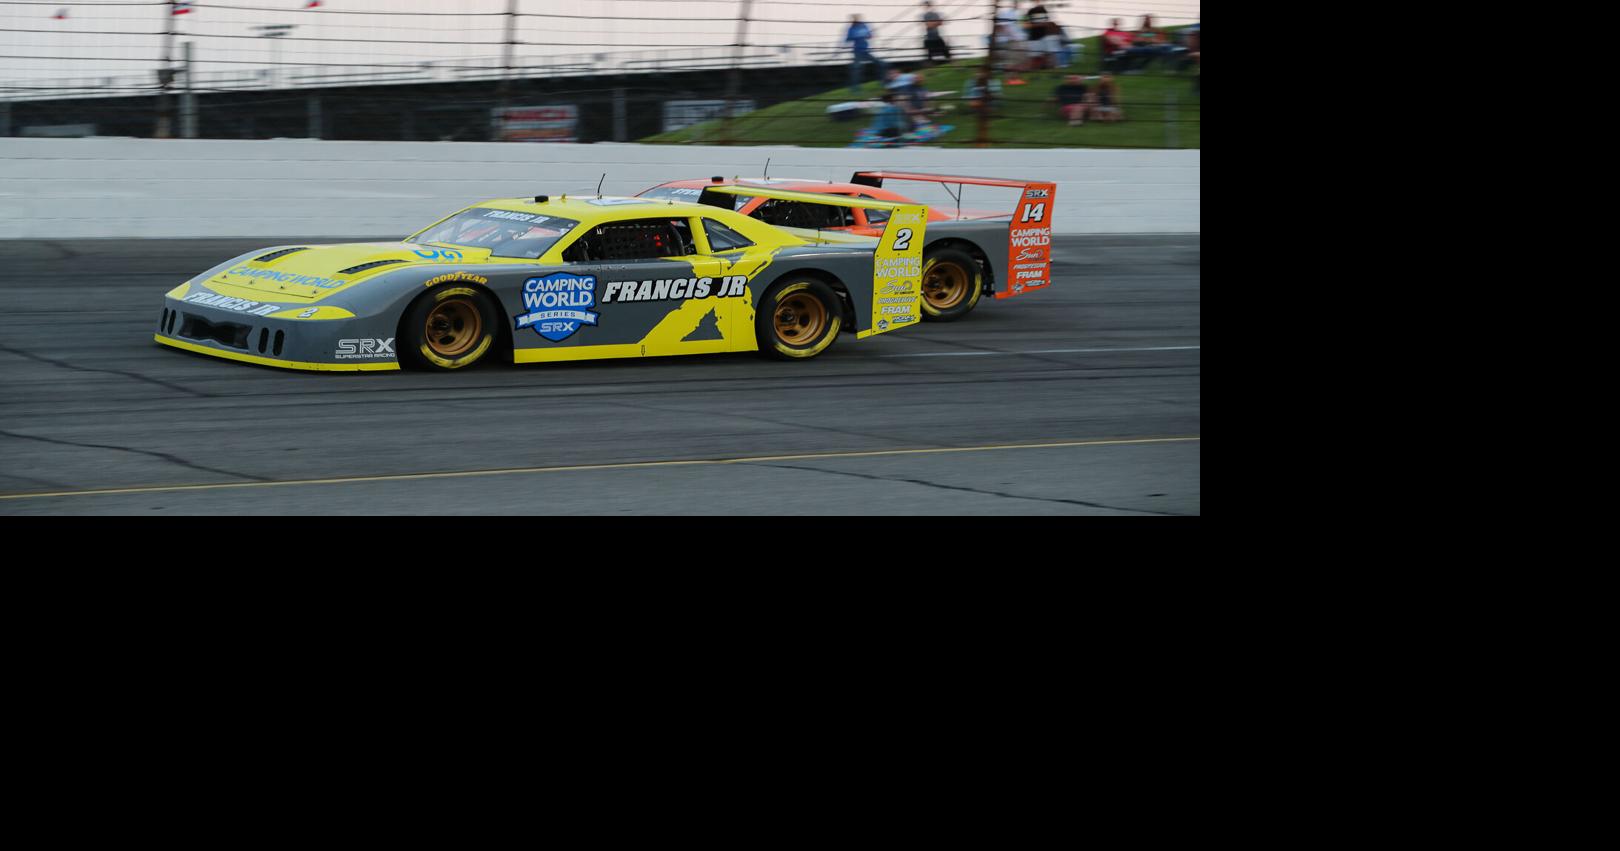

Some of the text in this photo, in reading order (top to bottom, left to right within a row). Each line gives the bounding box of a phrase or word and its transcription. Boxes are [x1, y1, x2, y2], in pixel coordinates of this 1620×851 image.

[1026, 189, 1048, 198] SRX
[1021, 202, 1045, 223] 14
[892, 228, 913, 251] 2
[1011, 228, 1050, 238] CAMPING
[1011, 236, 1050, 247] WORLD
[876, 256, 920, 268] CAMPING
[228, 265, 346, 290] CAMPING WORLD
[424, 271, 488, 287] GOODYEAR
[876, 266, 920, 279] WORLD
[1016, 270, 1043, 280] FRAM
[525, 277, 594, 293] CAMPING
[601, 275, 748, 303] FRANCIS JR
[183, 291, 281, 316] FRANCIS JR
[524, 291, 593, 308] WORLD
[297, 307, 319, 319] 2
[540, 311, 576, 319] SERIES
[881, 305, 911, 315] FRAM
[540, 321, 575, 333] SRX
[335, 337, 395, 354] SRX
